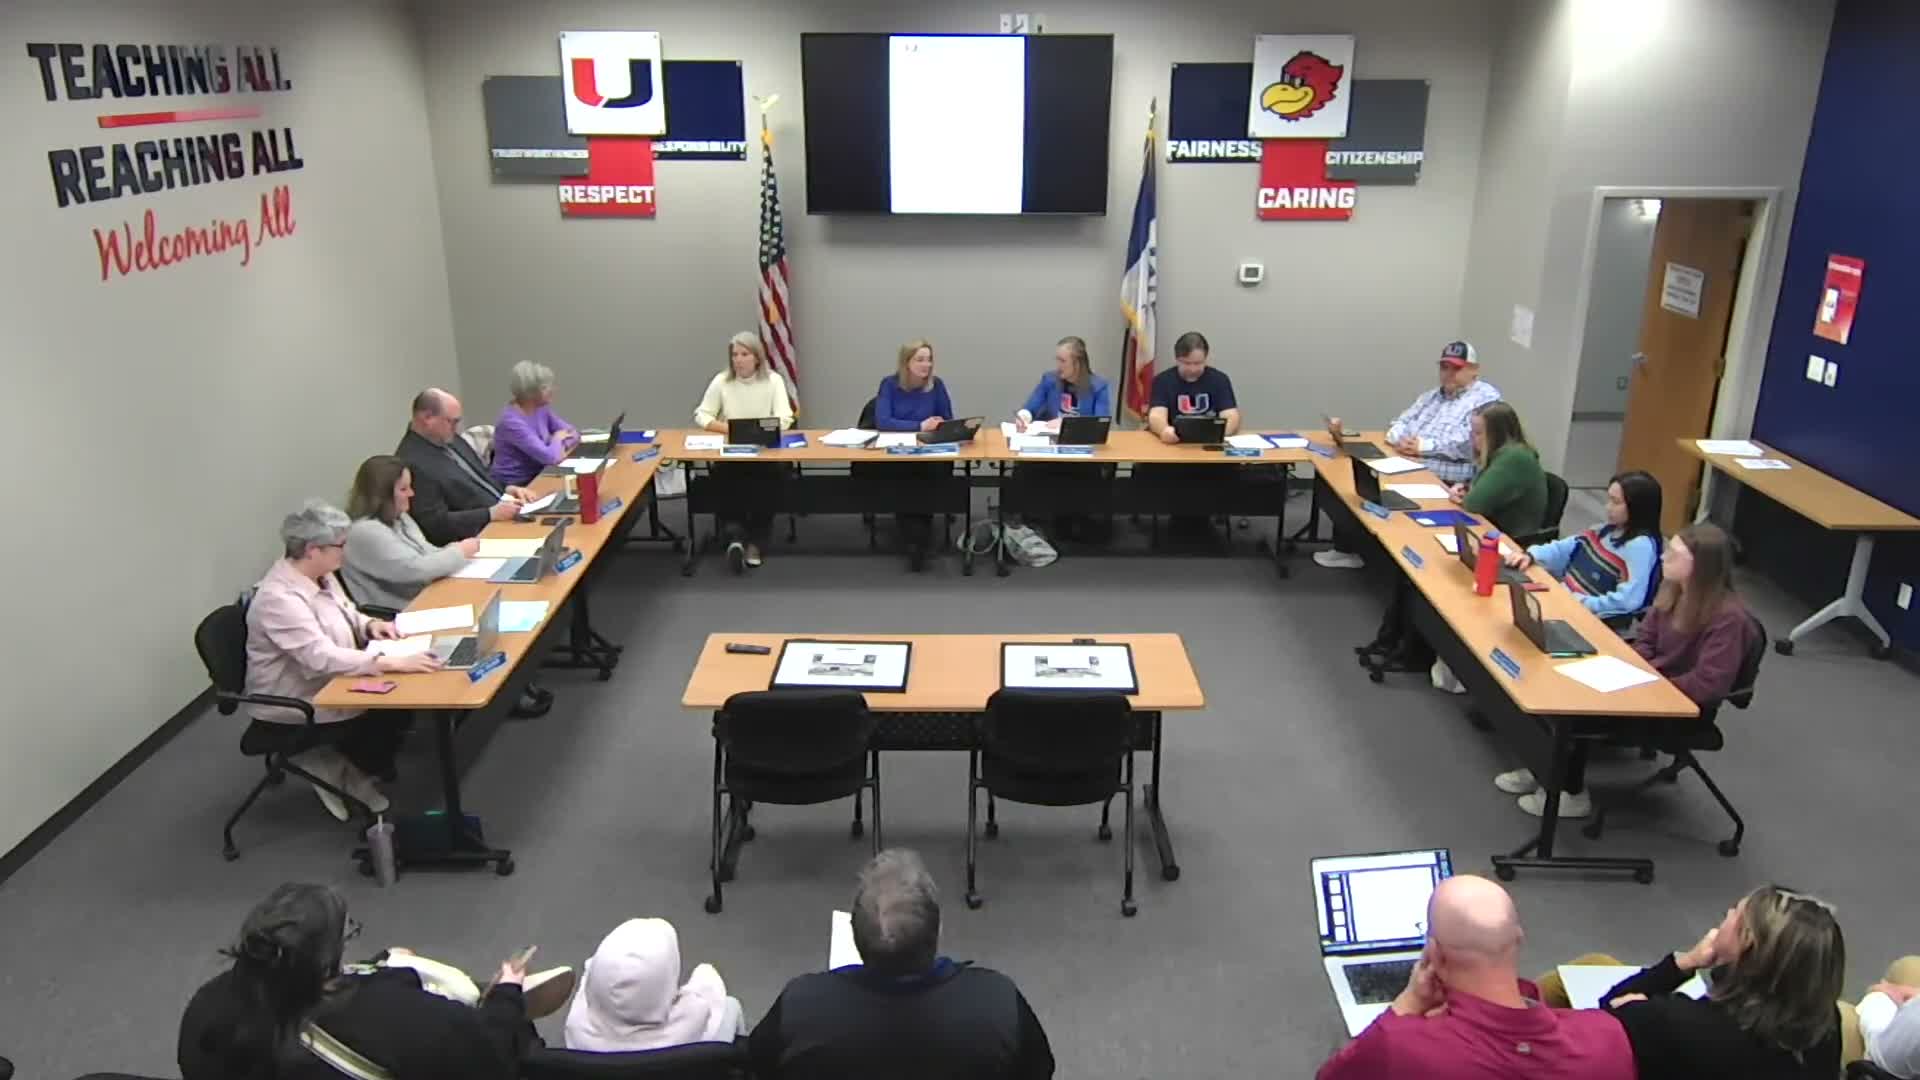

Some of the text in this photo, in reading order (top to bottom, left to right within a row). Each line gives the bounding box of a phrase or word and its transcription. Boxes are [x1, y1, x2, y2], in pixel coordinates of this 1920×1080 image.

[26, 42, 292, 101] TEACHING ALL
[571, 57, 653, 108] U
[650, 140, 748, 152] SPOIBILITY
[1166, 140, 1263, 158] FAIRNESS
[48, 127, 304, 208] REACHING ALL
[1325, 151, 1424, 165] CITIZENSHIP
[559, 185, 655, 204] RESPECT
[1258, 187, 1356, 208] CARING
[93, 185, 296, 281] Welcoming All
[1177, 393, 1210, 414] U
